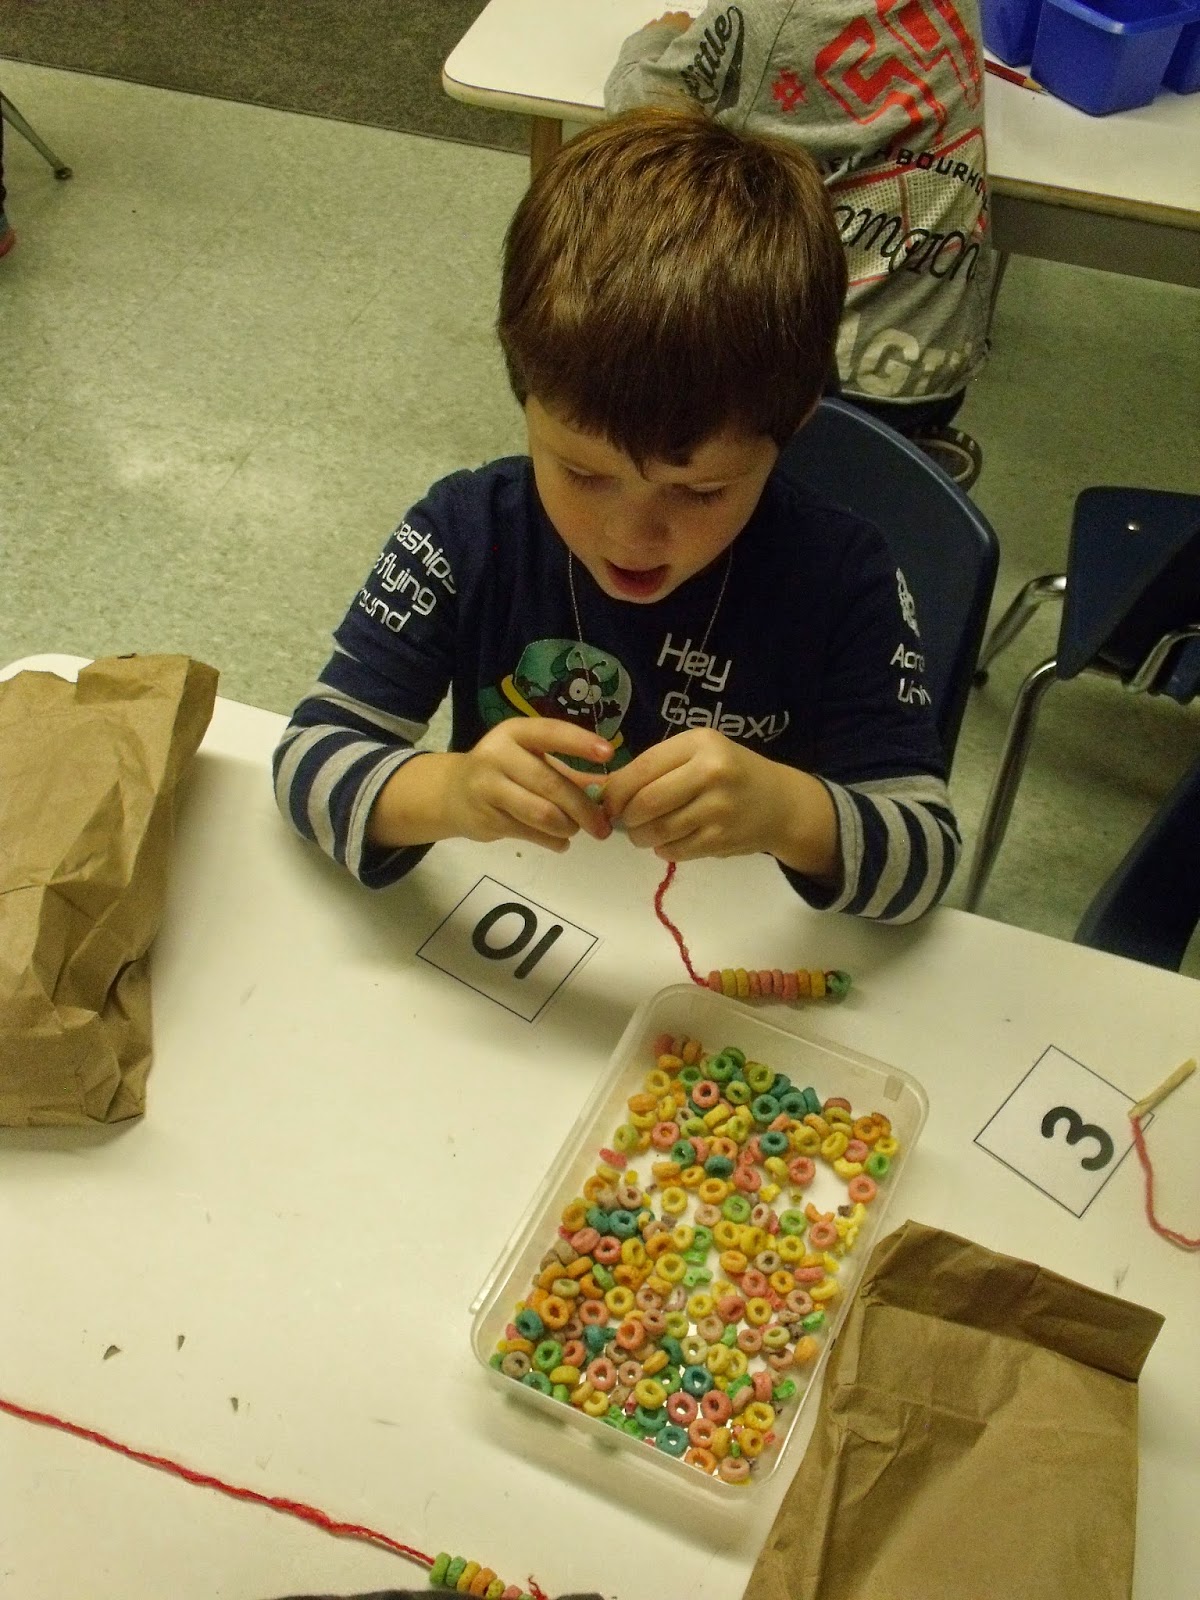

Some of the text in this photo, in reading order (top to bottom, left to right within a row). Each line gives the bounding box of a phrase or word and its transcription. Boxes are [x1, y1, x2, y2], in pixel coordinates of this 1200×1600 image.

[377, 552, 437, 616] flying
[394, 521, 457, 595] eships
[656, 632, 732, 692] Hey
[661, 691, 790, 743] Galaxy
[472, 902, 564, 980] 10
[1041, 1106, 1115, 1171] 3
